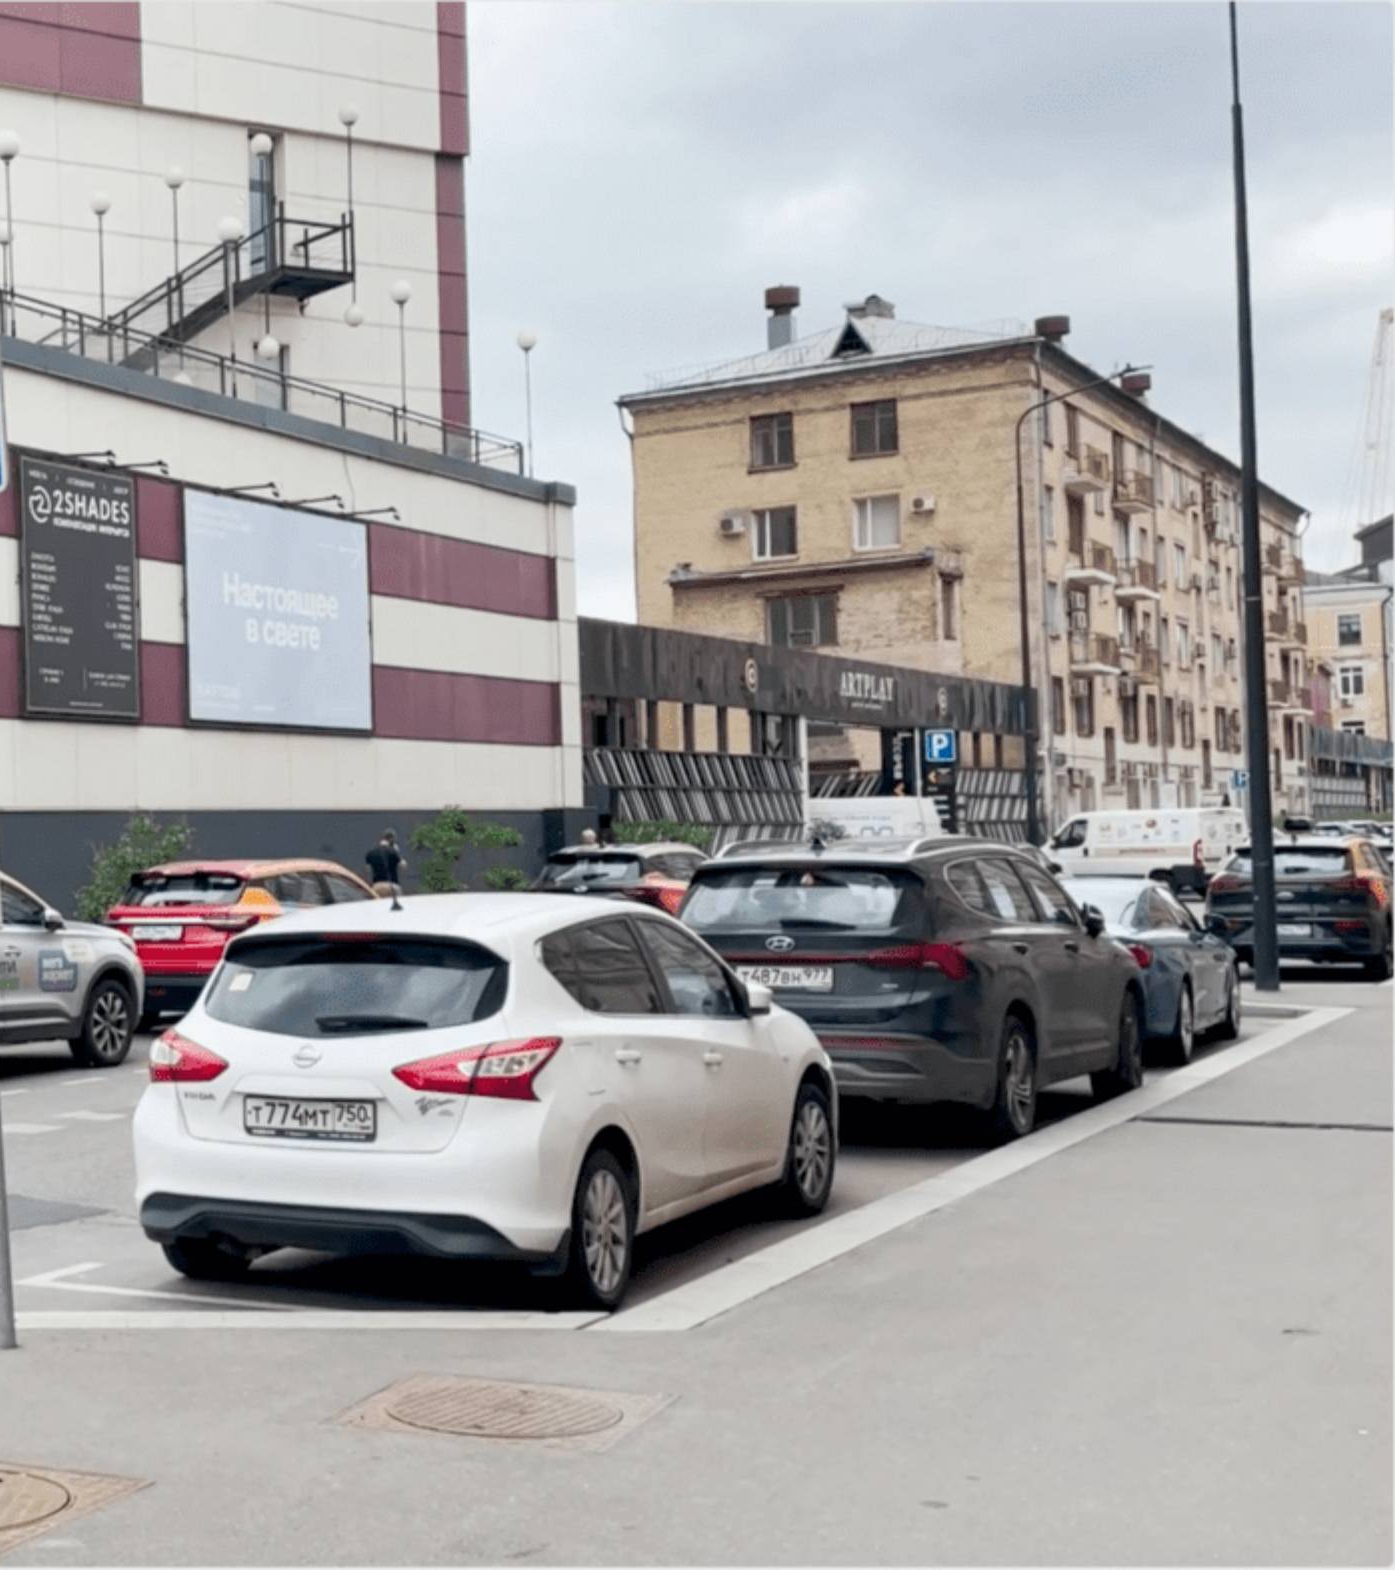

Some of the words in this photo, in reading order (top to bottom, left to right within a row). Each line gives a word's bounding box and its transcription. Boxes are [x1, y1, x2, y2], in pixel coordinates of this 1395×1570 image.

[52, 489, 130, 525] 2SHADES
[222, 571, 340, 620] Настоящее
[246, 618, 258, 642] в
[262, 619, 322, 651] свете
[839, 671, 894, 701] ARTPLAY
[931, 733, 949, 759] P
[252, 1102, 331, 1127] Т774МТ
[336, 1103, 369, 1123] 750
